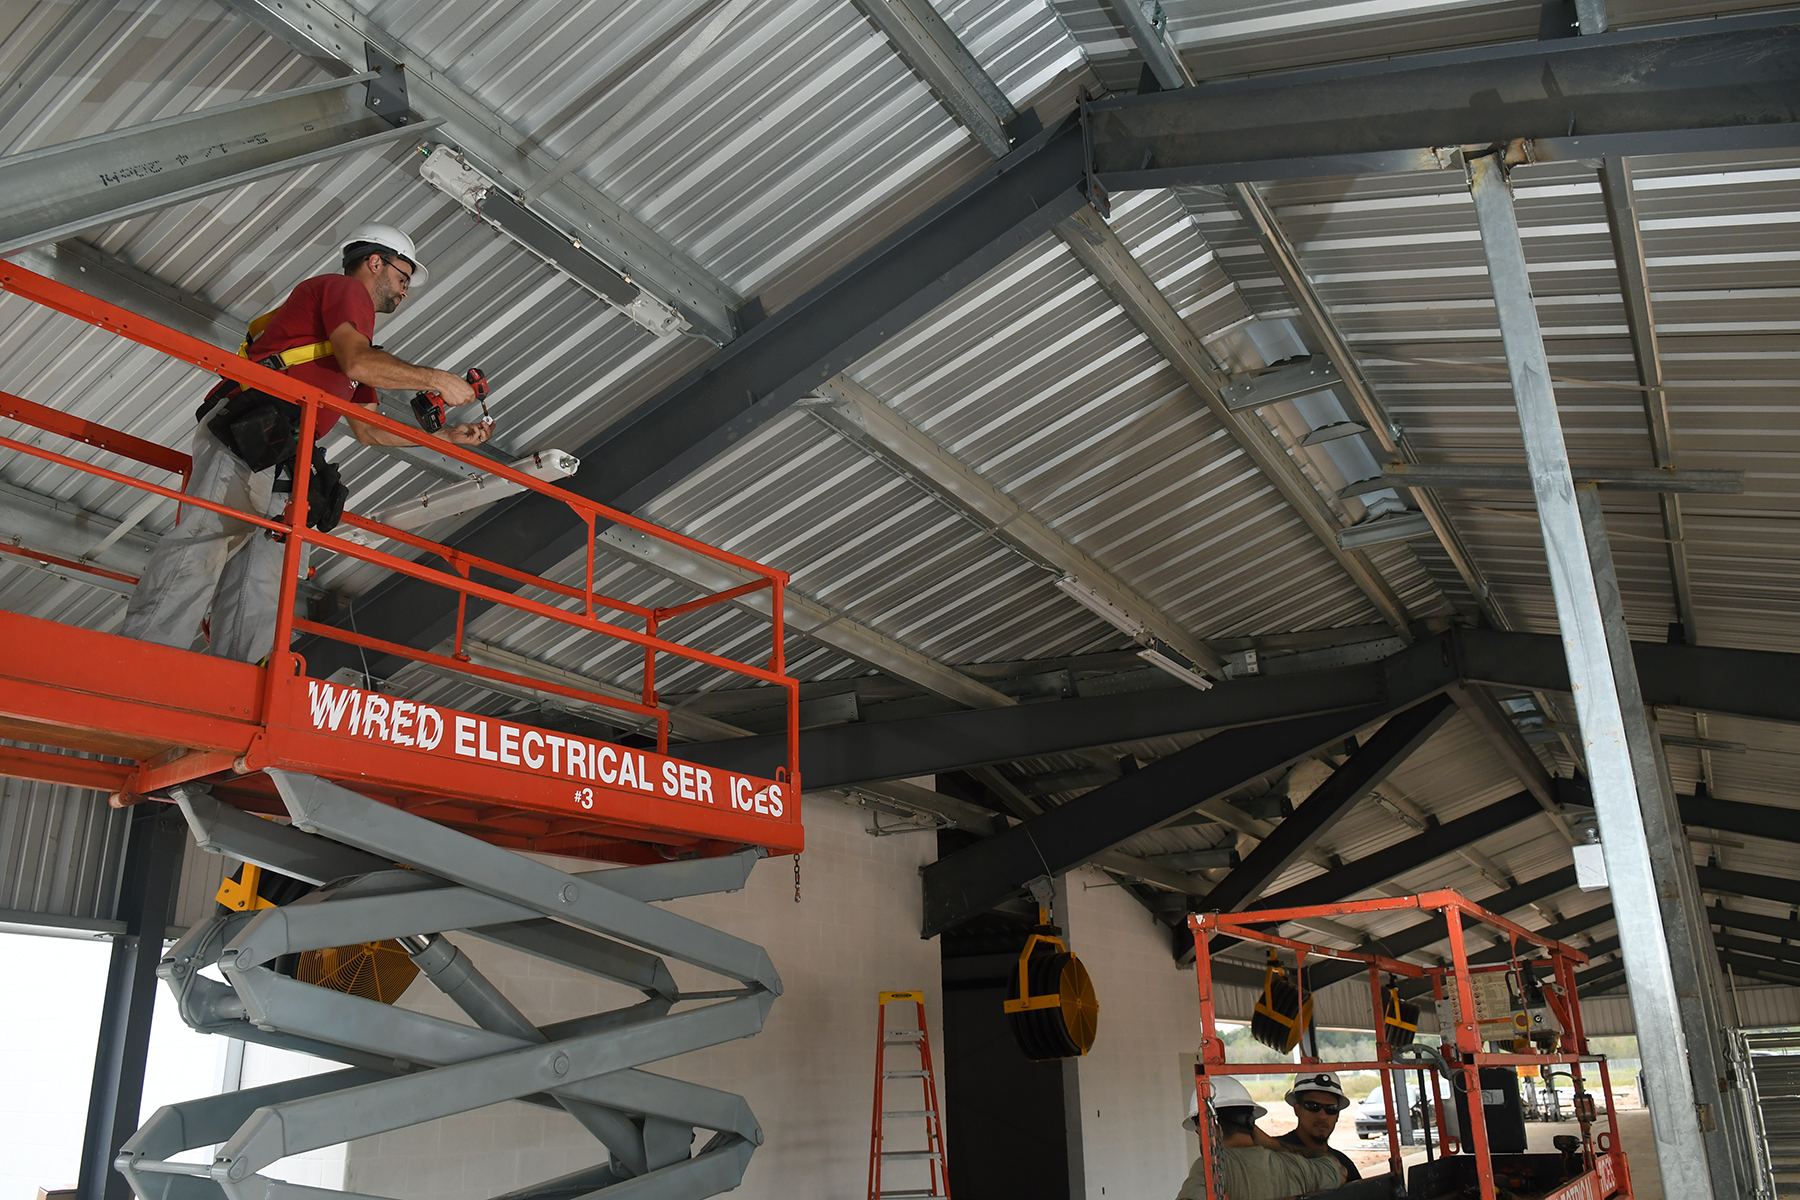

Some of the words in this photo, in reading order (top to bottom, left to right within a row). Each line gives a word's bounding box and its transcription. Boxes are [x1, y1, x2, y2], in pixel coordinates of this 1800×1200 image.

[308, 681, 444, 751] WIRED
[455, 716, 654, 791] ELECTRICAL
[573, 788, 594, 809] #3
